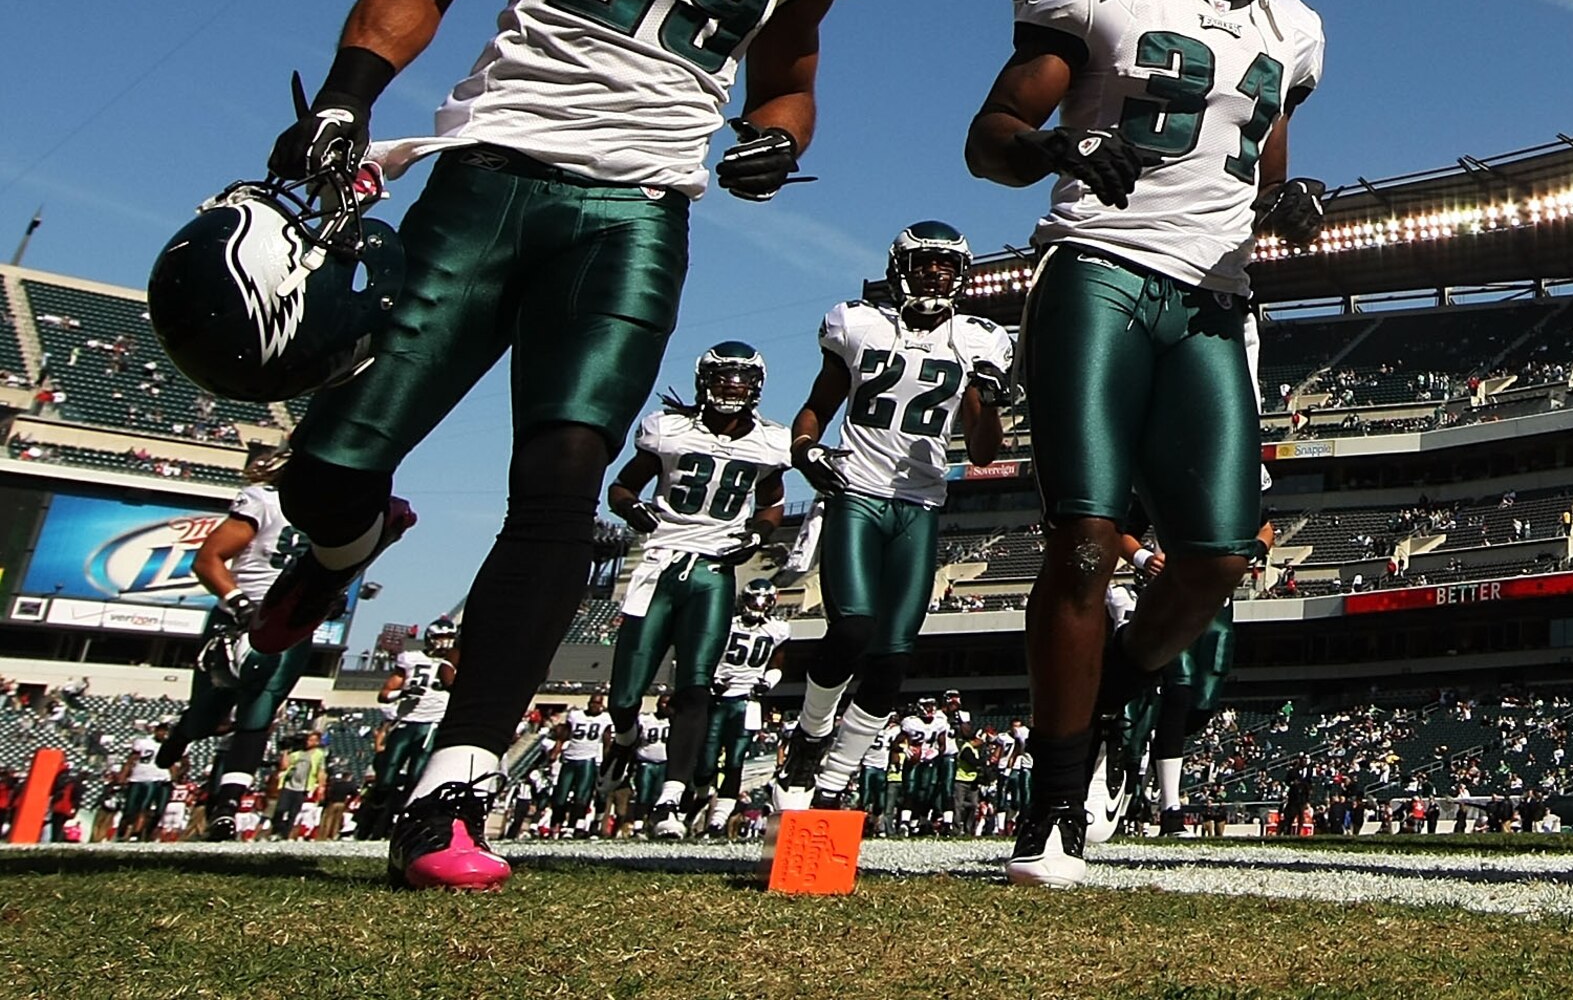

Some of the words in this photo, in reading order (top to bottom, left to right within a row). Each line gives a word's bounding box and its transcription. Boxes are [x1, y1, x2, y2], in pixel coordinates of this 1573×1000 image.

[1119, 31, 1284, 186] 31
[850, 349, 964, 437] 22
[1294, 445, 1332, 457] Snapple
[973, 465, 1015, 477] Sovereign
[668, 453, 757, 521] 38
[1436, 582, 1501, 605] BETTER
[110, 613, 159, 626] verizon
[725, 631, 774, 668] 50
[573, 723, 601, 741] 58
